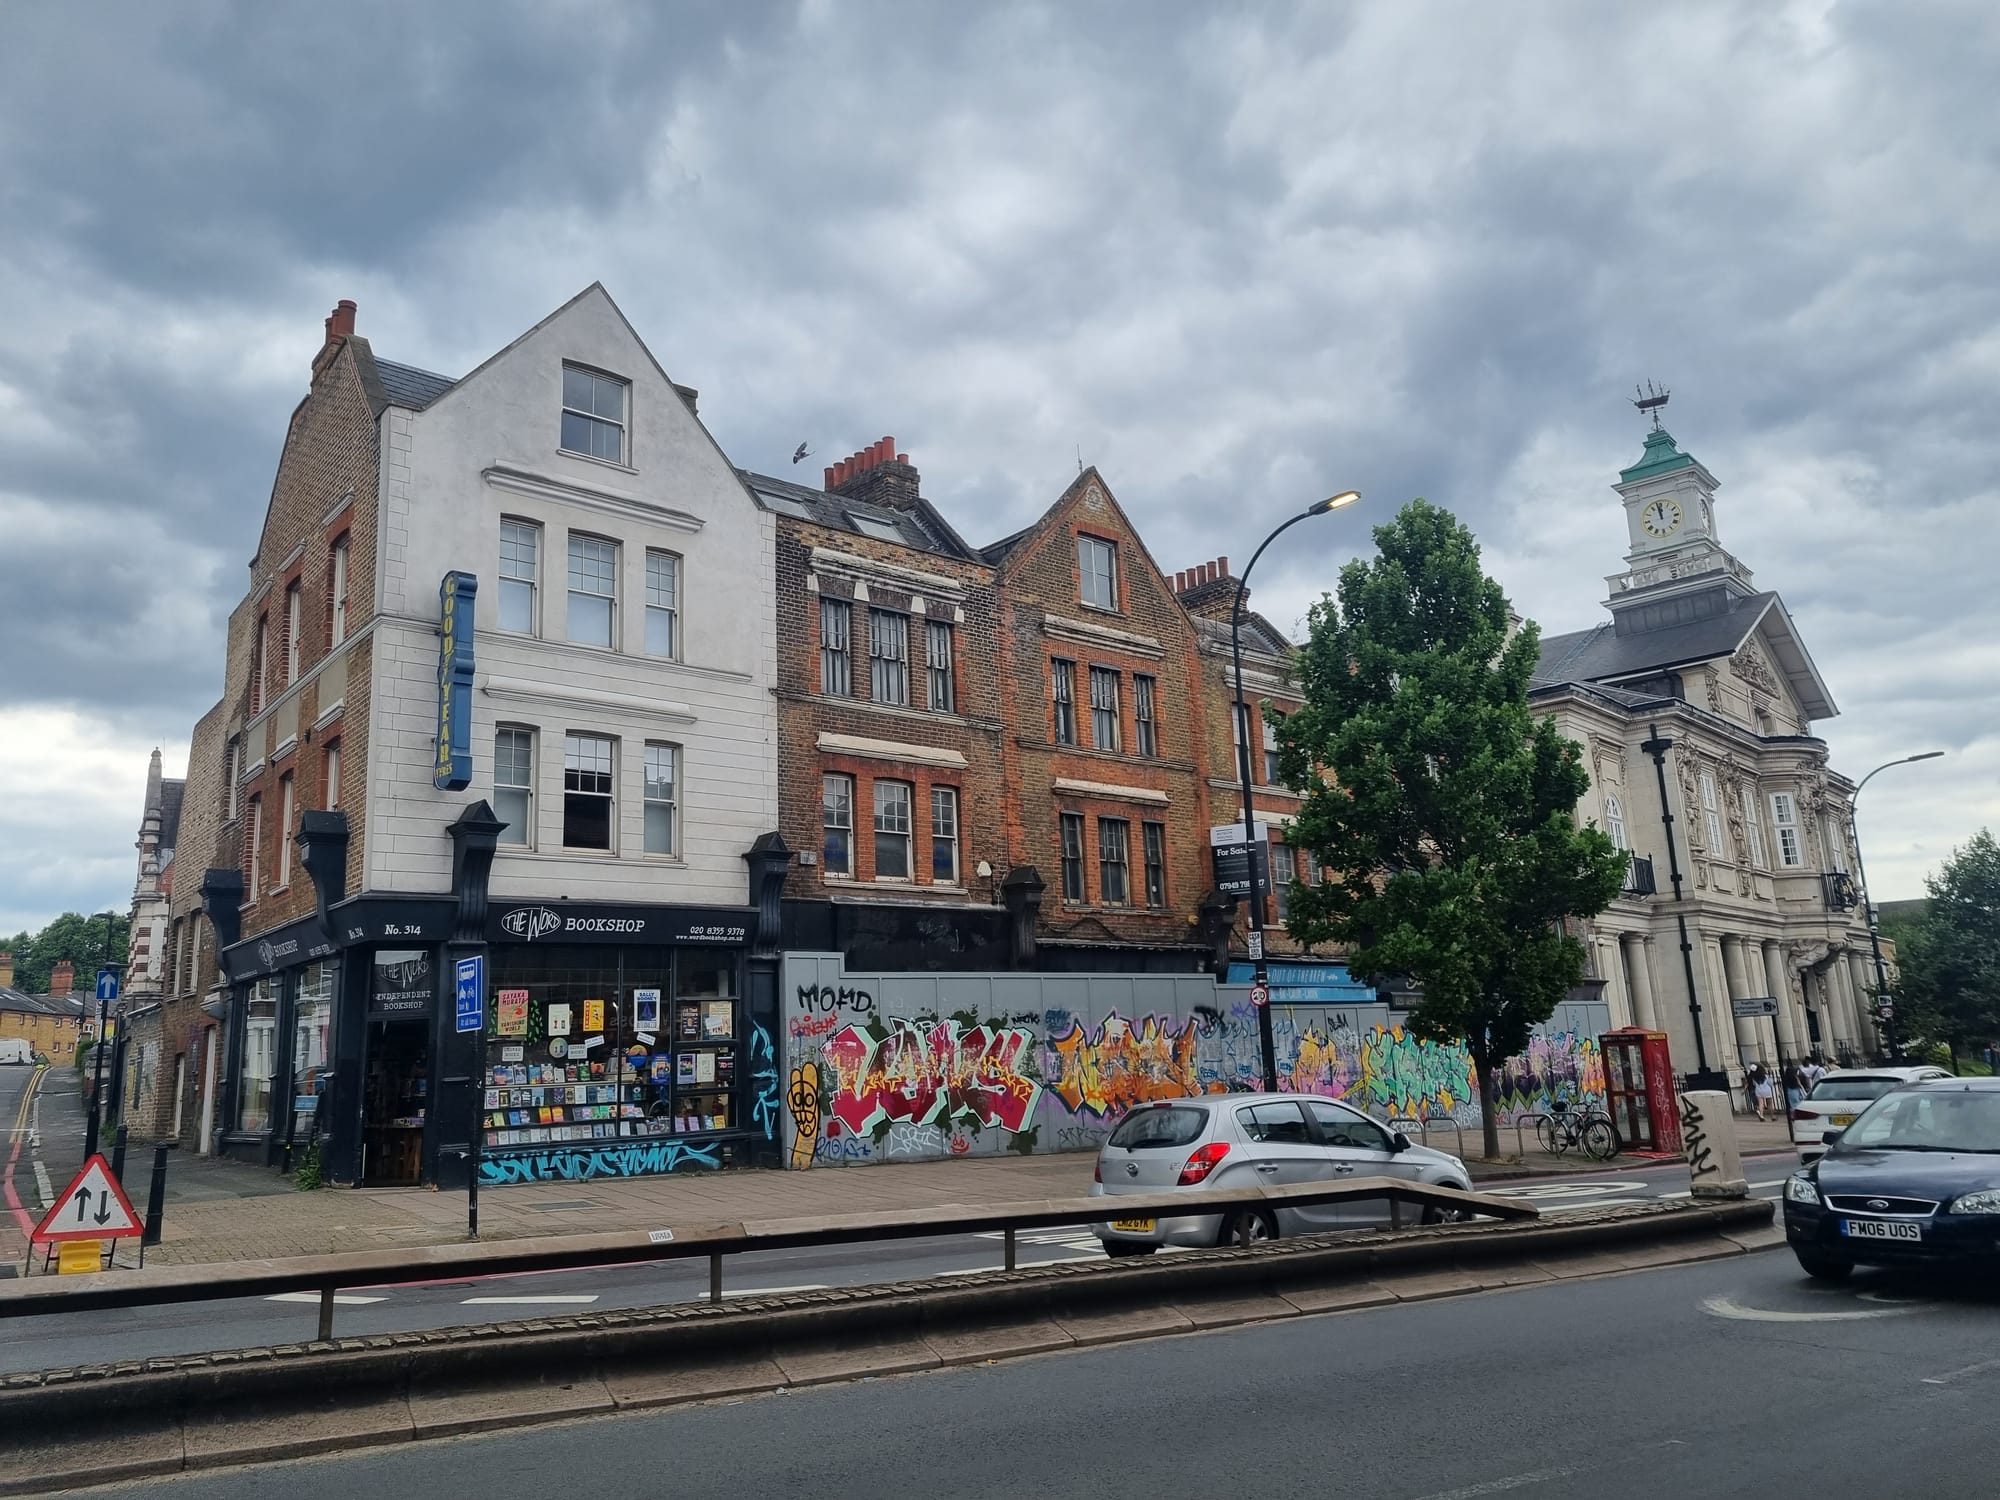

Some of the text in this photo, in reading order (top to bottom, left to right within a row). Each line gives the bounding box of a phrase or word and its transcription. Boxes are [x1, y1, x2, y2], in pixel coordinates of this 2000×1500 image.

[440, 577, 455, 763] GOODYEAR
[504, 906, 645, 941] THE WORD BOOKSHOP
[384, 924, 422, 935] No. 314
[689, 926, 745, 936] 020 8355 9378
[375, 990, 431, 1001] INDEPENDENT
[1253, 991, 1265, 1000] 20
[384, 1001, 424, 1011] BOOKSHOP
[1849, 1220, 1918, 1239] FM06 UOS
